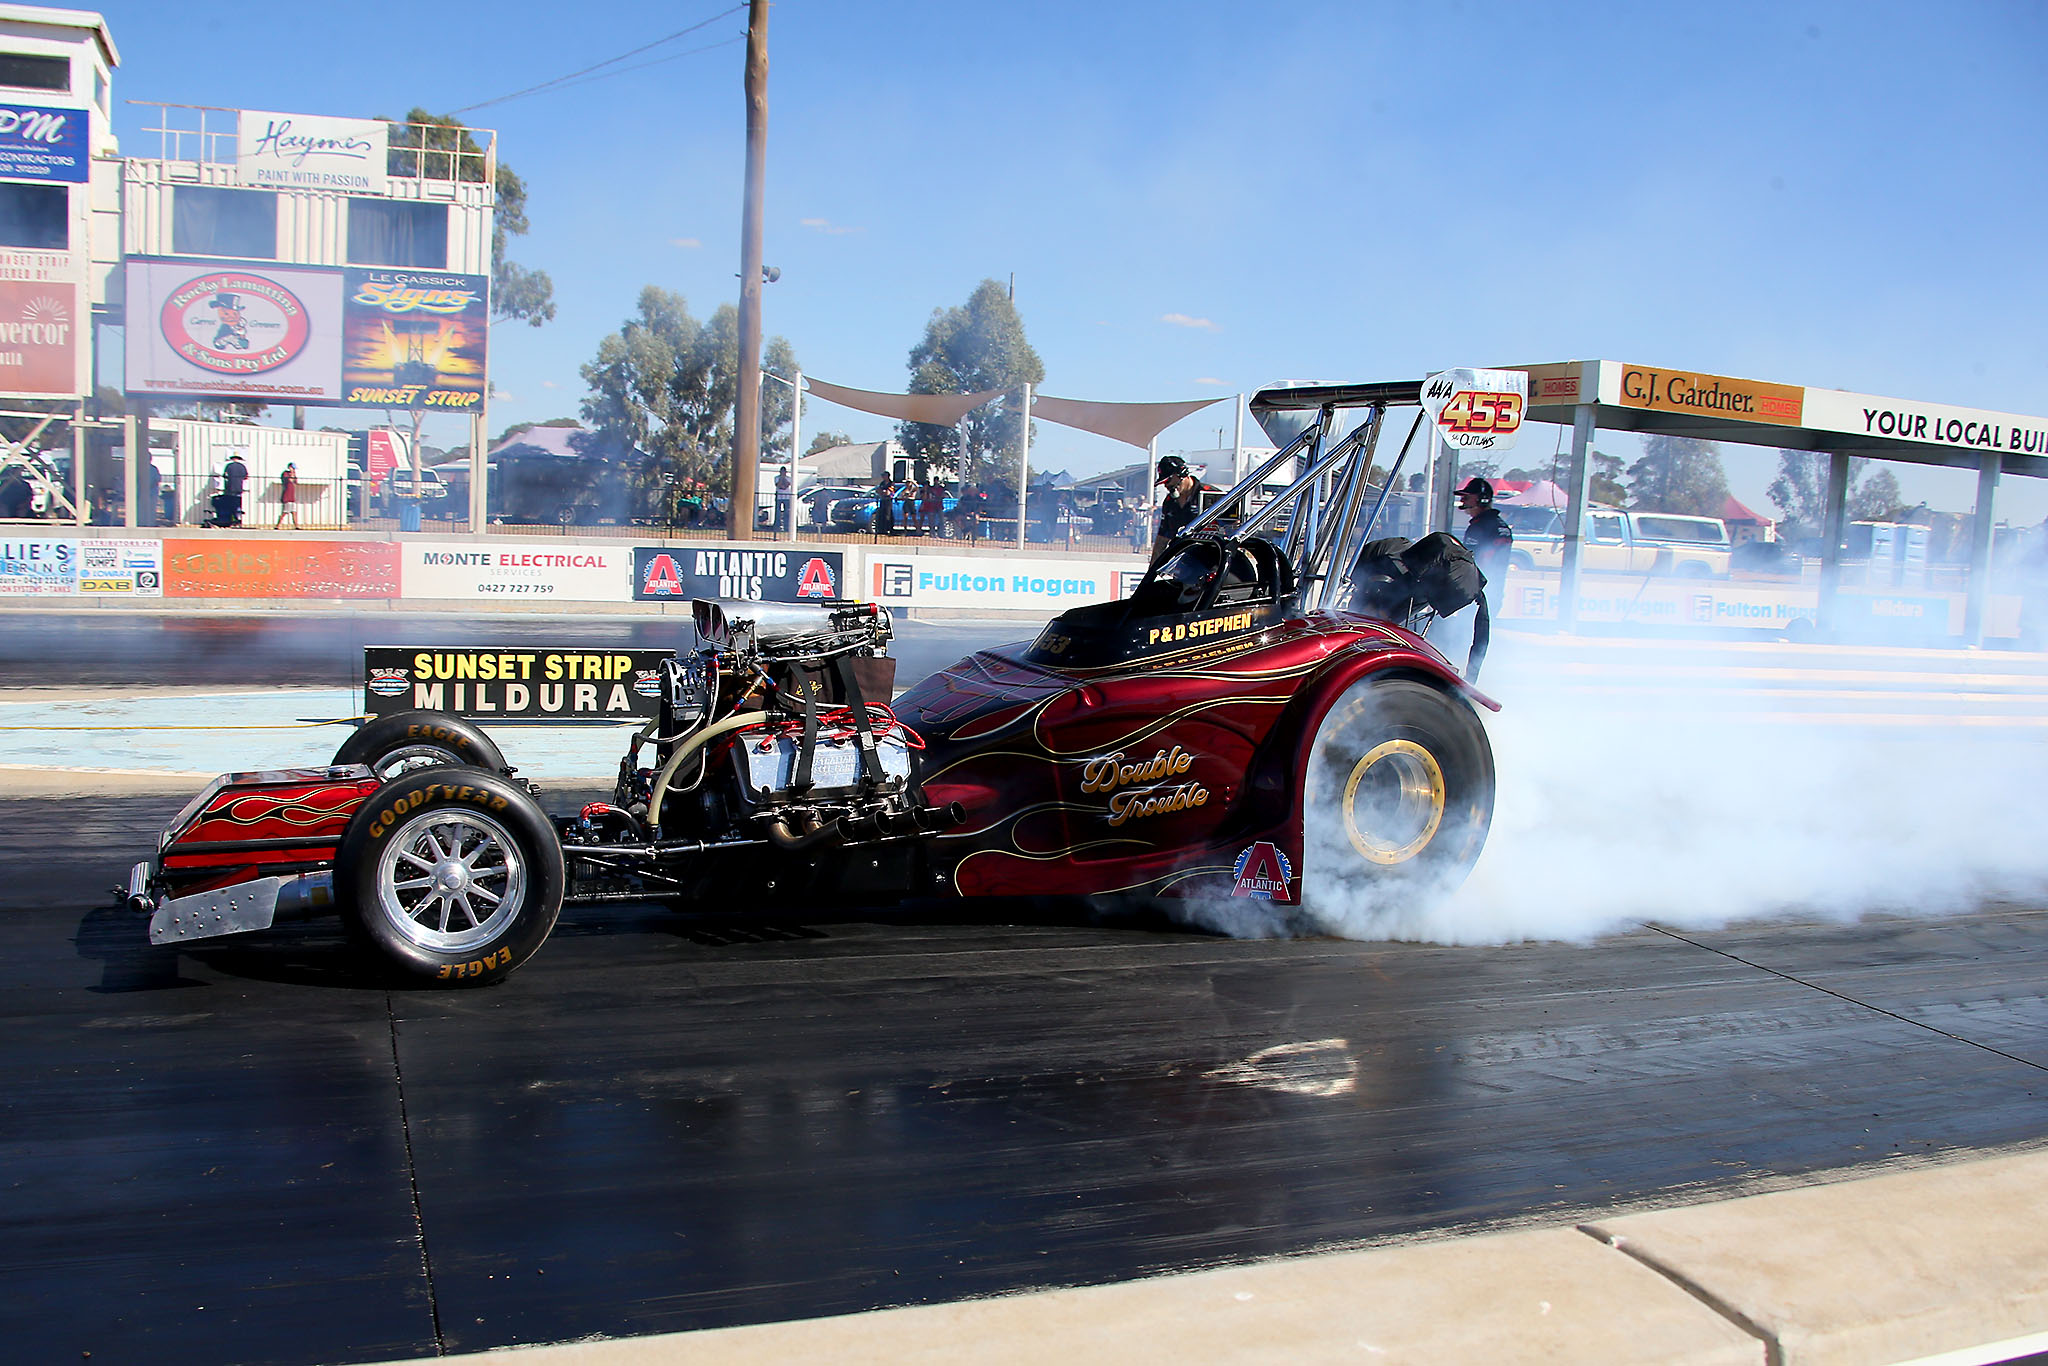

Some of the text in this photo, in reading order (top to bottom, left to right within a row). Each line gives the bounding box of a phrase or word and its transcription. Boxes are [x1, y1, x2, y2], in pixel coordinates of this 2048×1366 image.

[257, 169, 369, 187] PAINT WITH PASSION
[369, 272, 466, 287] LE GASSICK
[351, 282, 482, 314] Signs
[198, 350, 233, 369] Sons
[234, 358, 260, 372] Pty
[261, 346, 288, 367] Ltd
[347, 387, 480, 407] SUNSET STRIP
[1544, 381, 1577, 392] HOMES
[1624, 370, 1754, 414] G.J. Gardner.
[1439, 391, 1523, 434] 453
[1762, 400, 1799, 415] HOMES
[1863, 408, 1926, 438] YOUR
[1935, 416, 2002, 448] LOCAL
[5, 543, 69, 560] LIE'S
[171, 549, 271, 574] coates
[423, 552, 607, 568] MONTE ELECTRICAL
[695, 550, 787, 578] ATLANTIC
[6, 563, 69, 573] ERING
[489, 568, 543, 577] SERVICES
[82, 581, 130, 590] DAB
[478, 583, 554, 594] 0427 727 759
[648, 580, 679, 588] ATLANTIC
[719, 575, 763, 601] OILS
[801, 582, 830, 591] ATLANTIC
[918, 571, 1002, 593] Fulton
[1012, 574, 1096, 597] Hogan
[1716, 601, 1772, 618] Fulton
[1149, 613, 1252, 645] P & D STEPHEN
[413, 653, 633, 681] SUNSET STRIP
[413, 683, 631, 712] MILDURA
[408, 724, 471, 749] EAGLE
[1080, 745, 1193, 793] Double
[369, 784, 509, 839] GOODYEAR
[1108, 782, 1210, 827] Trouble
[1240, 877, 1283, 891] ATLANTIC
[436, 945, 512, 980] EAGLE
